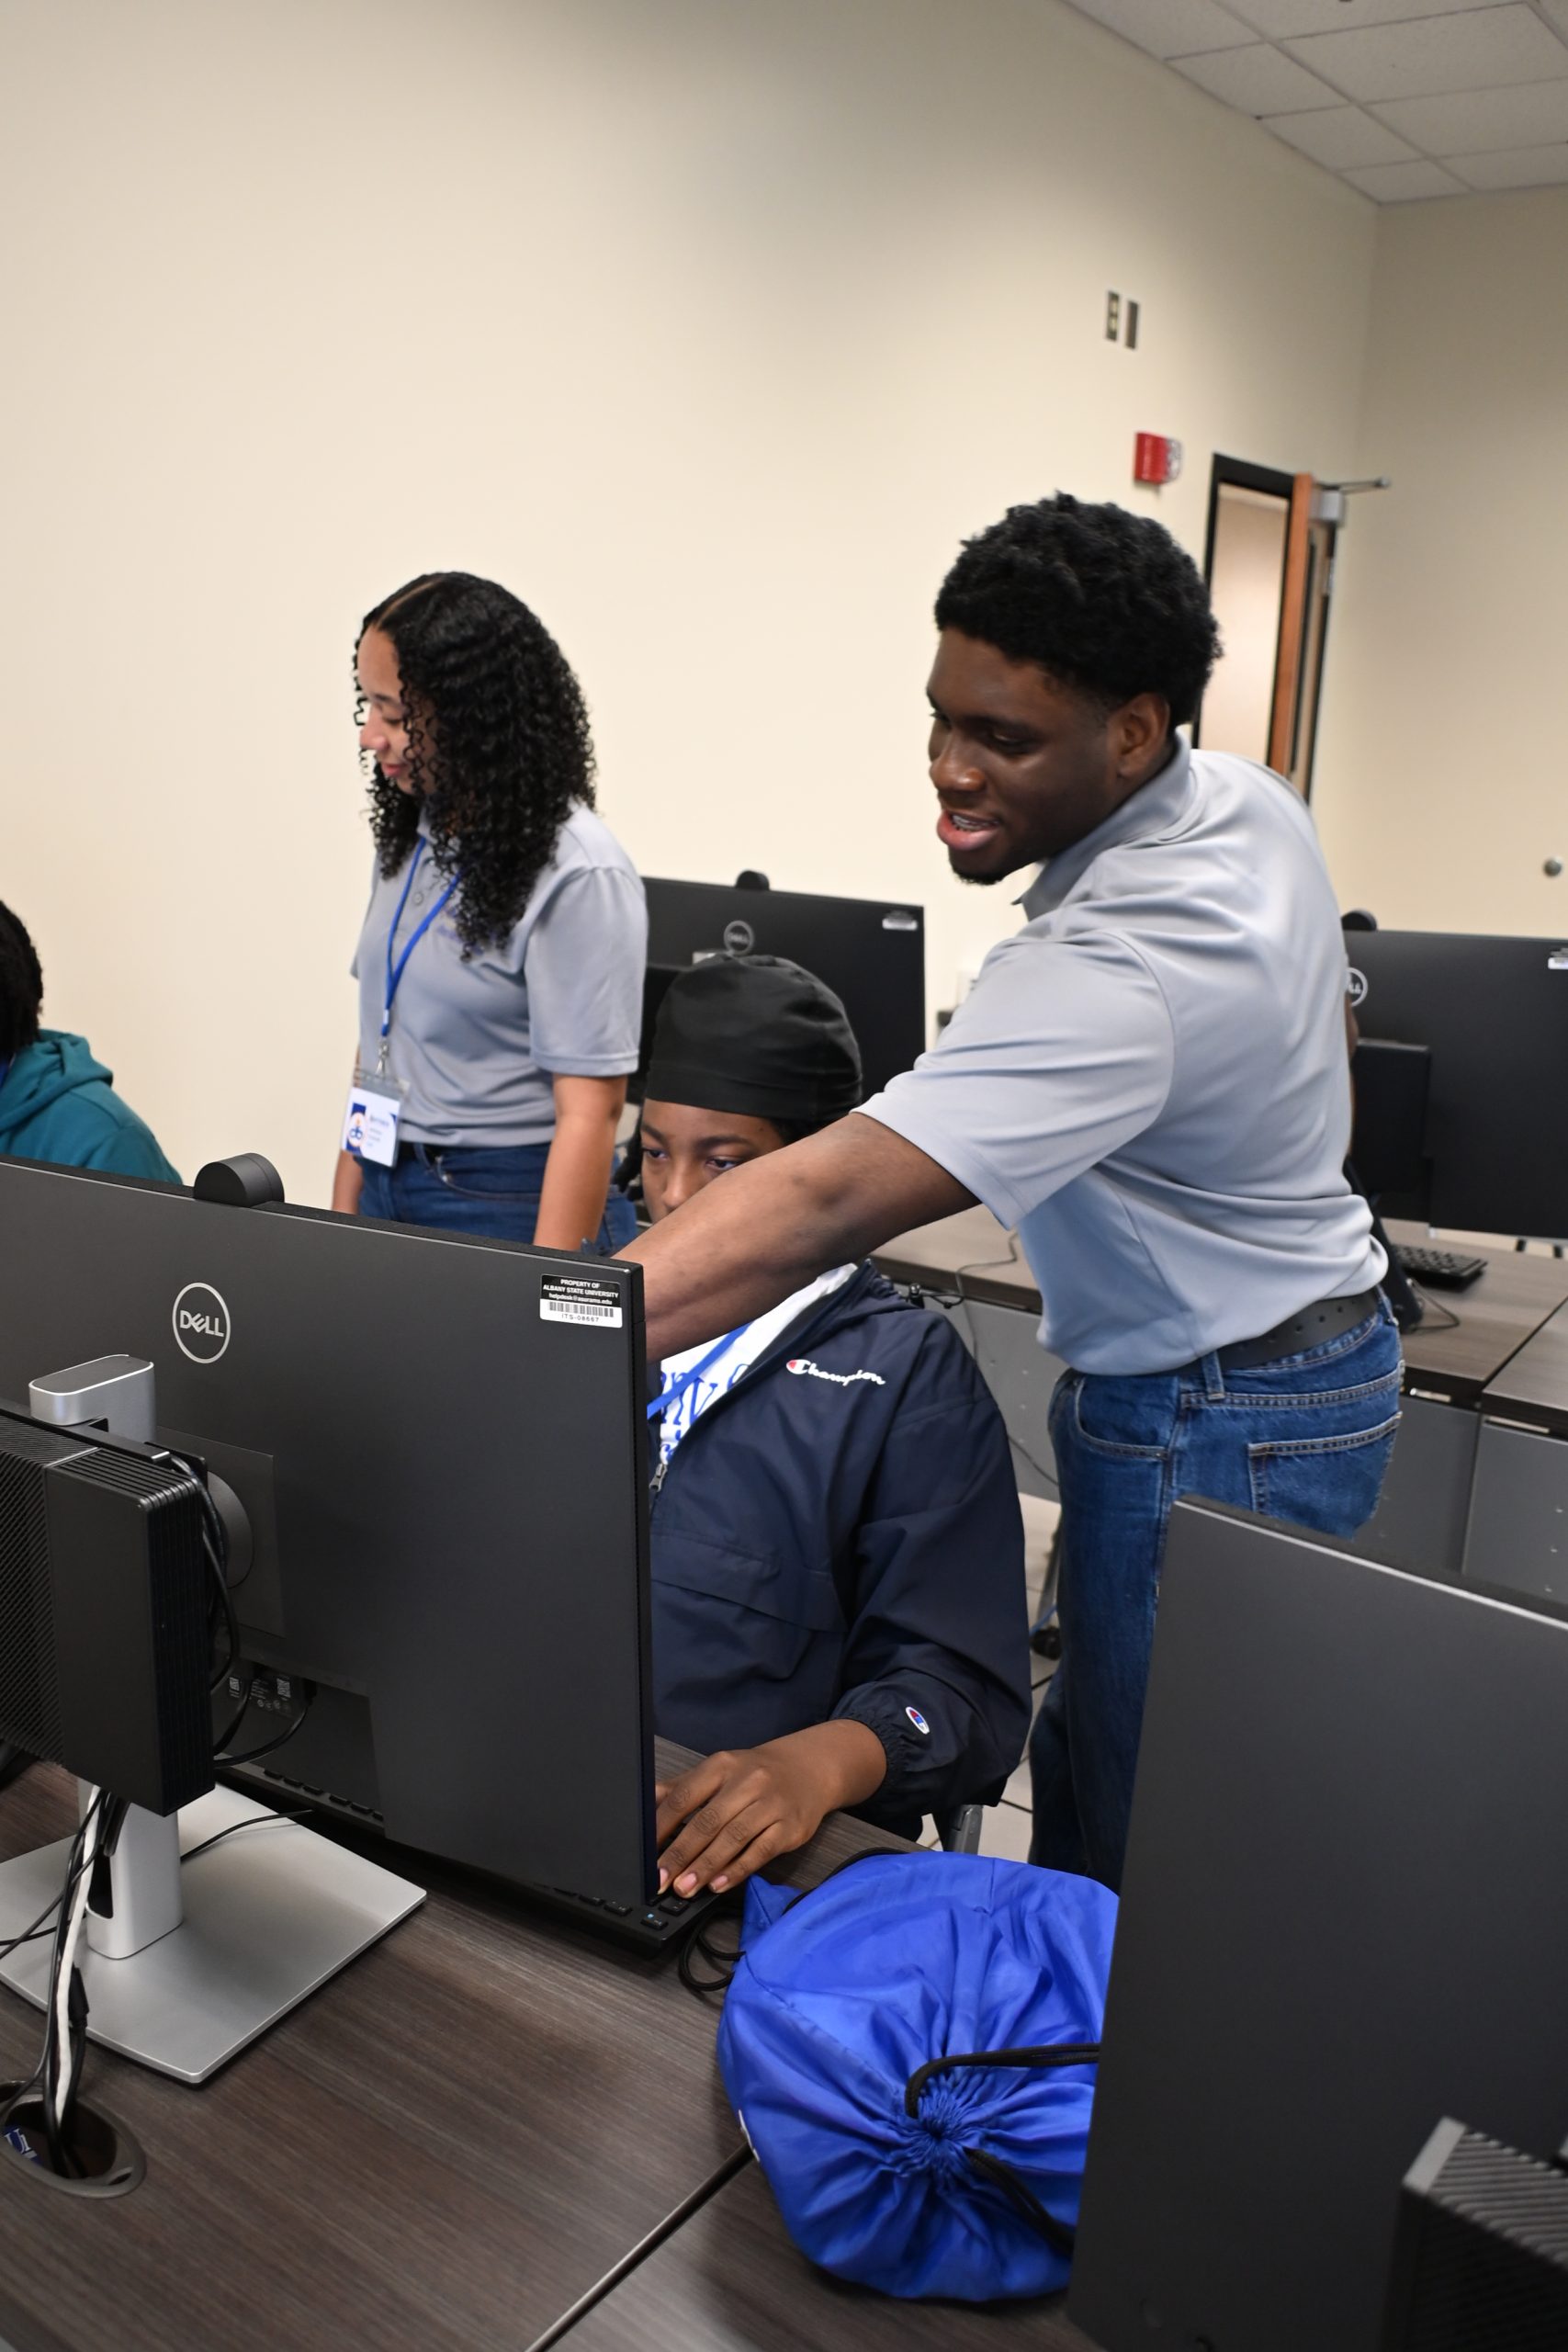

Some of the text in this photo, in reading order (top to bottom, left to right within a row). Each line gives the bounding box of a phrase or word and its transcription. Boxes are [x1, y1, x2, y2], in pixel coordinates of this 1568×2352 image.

[543, 1283, 619, 1298] ALBANY STATE UNIVERSITY
[560, 1279, 592, 1288] PROPERTY
[179, 1309, 225, 1338] DELL
[785, 1359, 886, 1386] Champion
